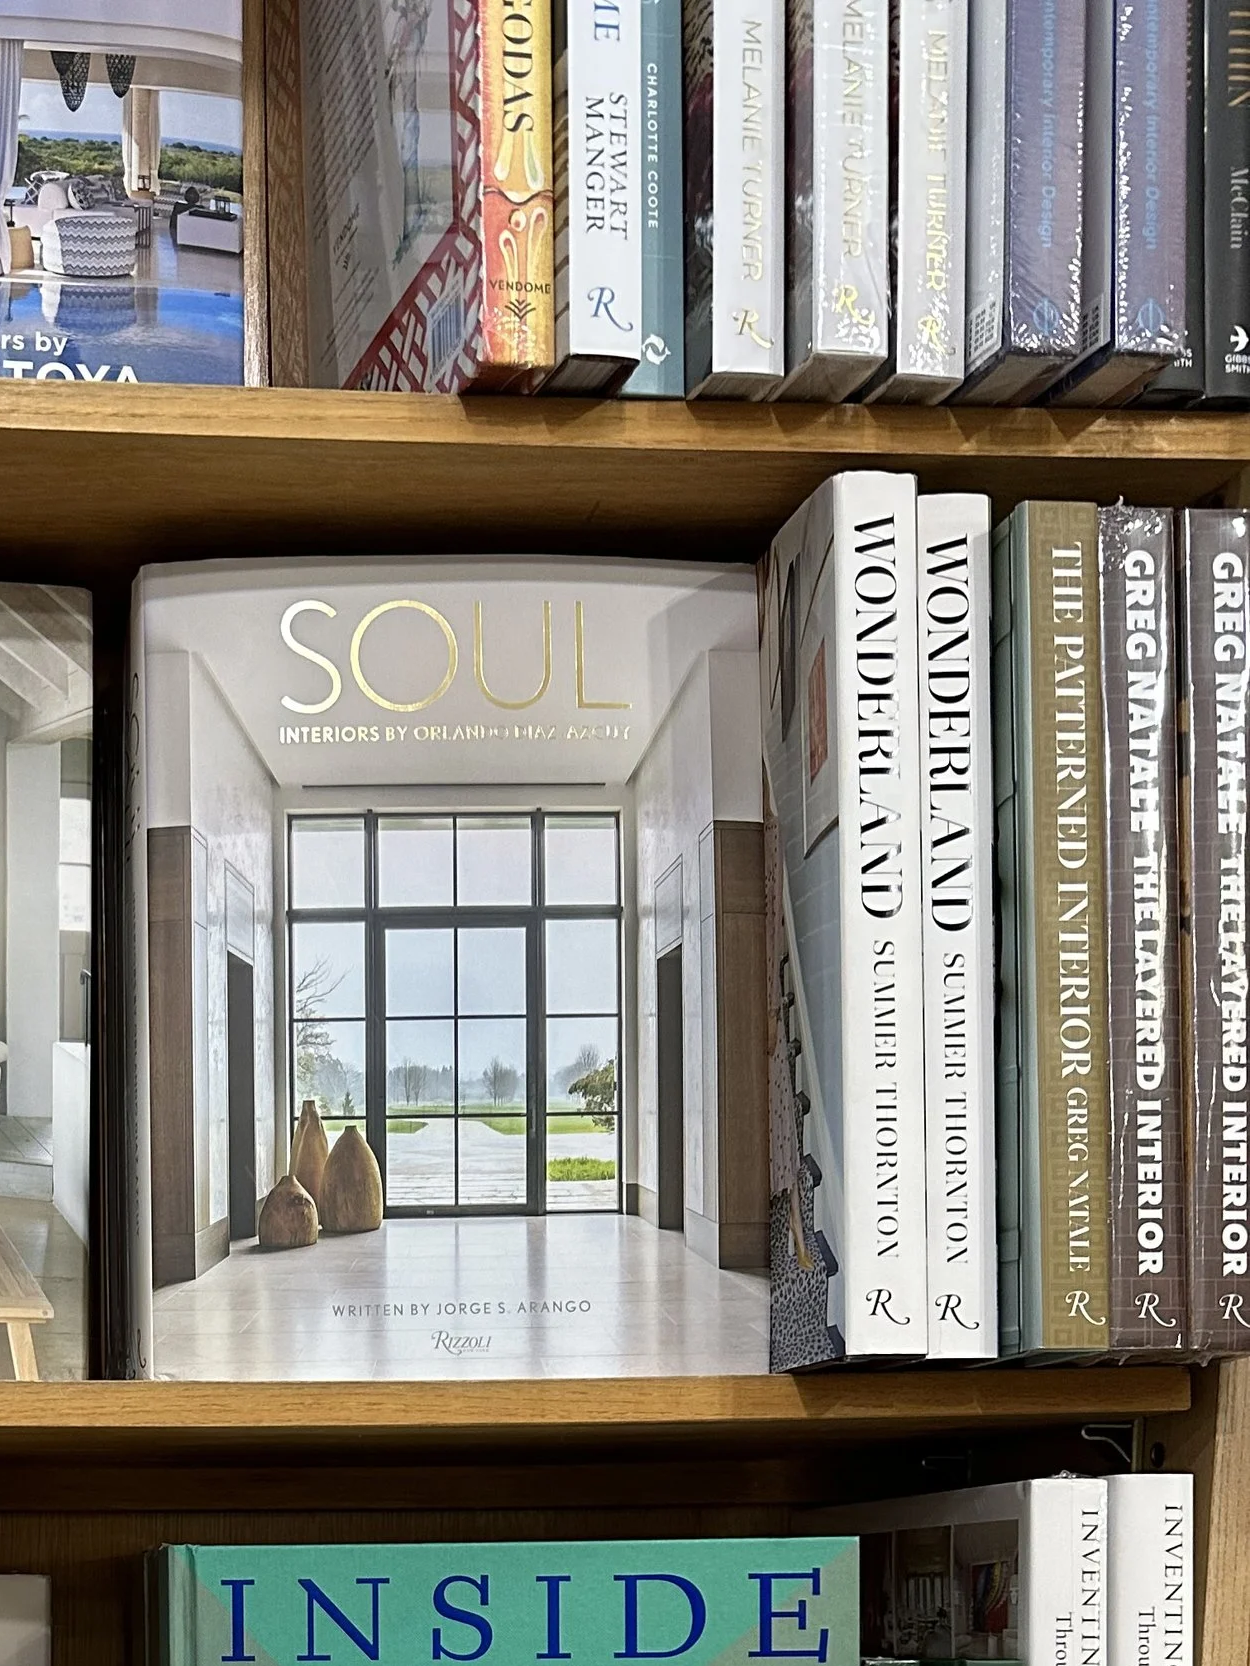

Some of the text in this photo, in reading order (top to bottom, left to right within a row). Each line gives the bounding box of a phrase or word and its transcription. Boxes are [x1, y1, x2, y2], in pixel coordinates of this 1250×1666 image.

[585, 96, 605, 233] MANGER
[609, 92, 629, 241] STEWART
[35, 329, 68, 357] by
[280, 599, 632, 714] SOUL
[280, 726, 407, 744] INTERIORS BY
[926, 533, 974, 1265] WONDERLAND SUMMER THORNTON
[1051, 541, 1093, 1272] THE PATTERNED INTERIOR GREG NATALE
[332, 1300, 591, 1317] WRITTEN BY JORGE ARANGO
[219, 1566, 829, 1663] INSIDE
